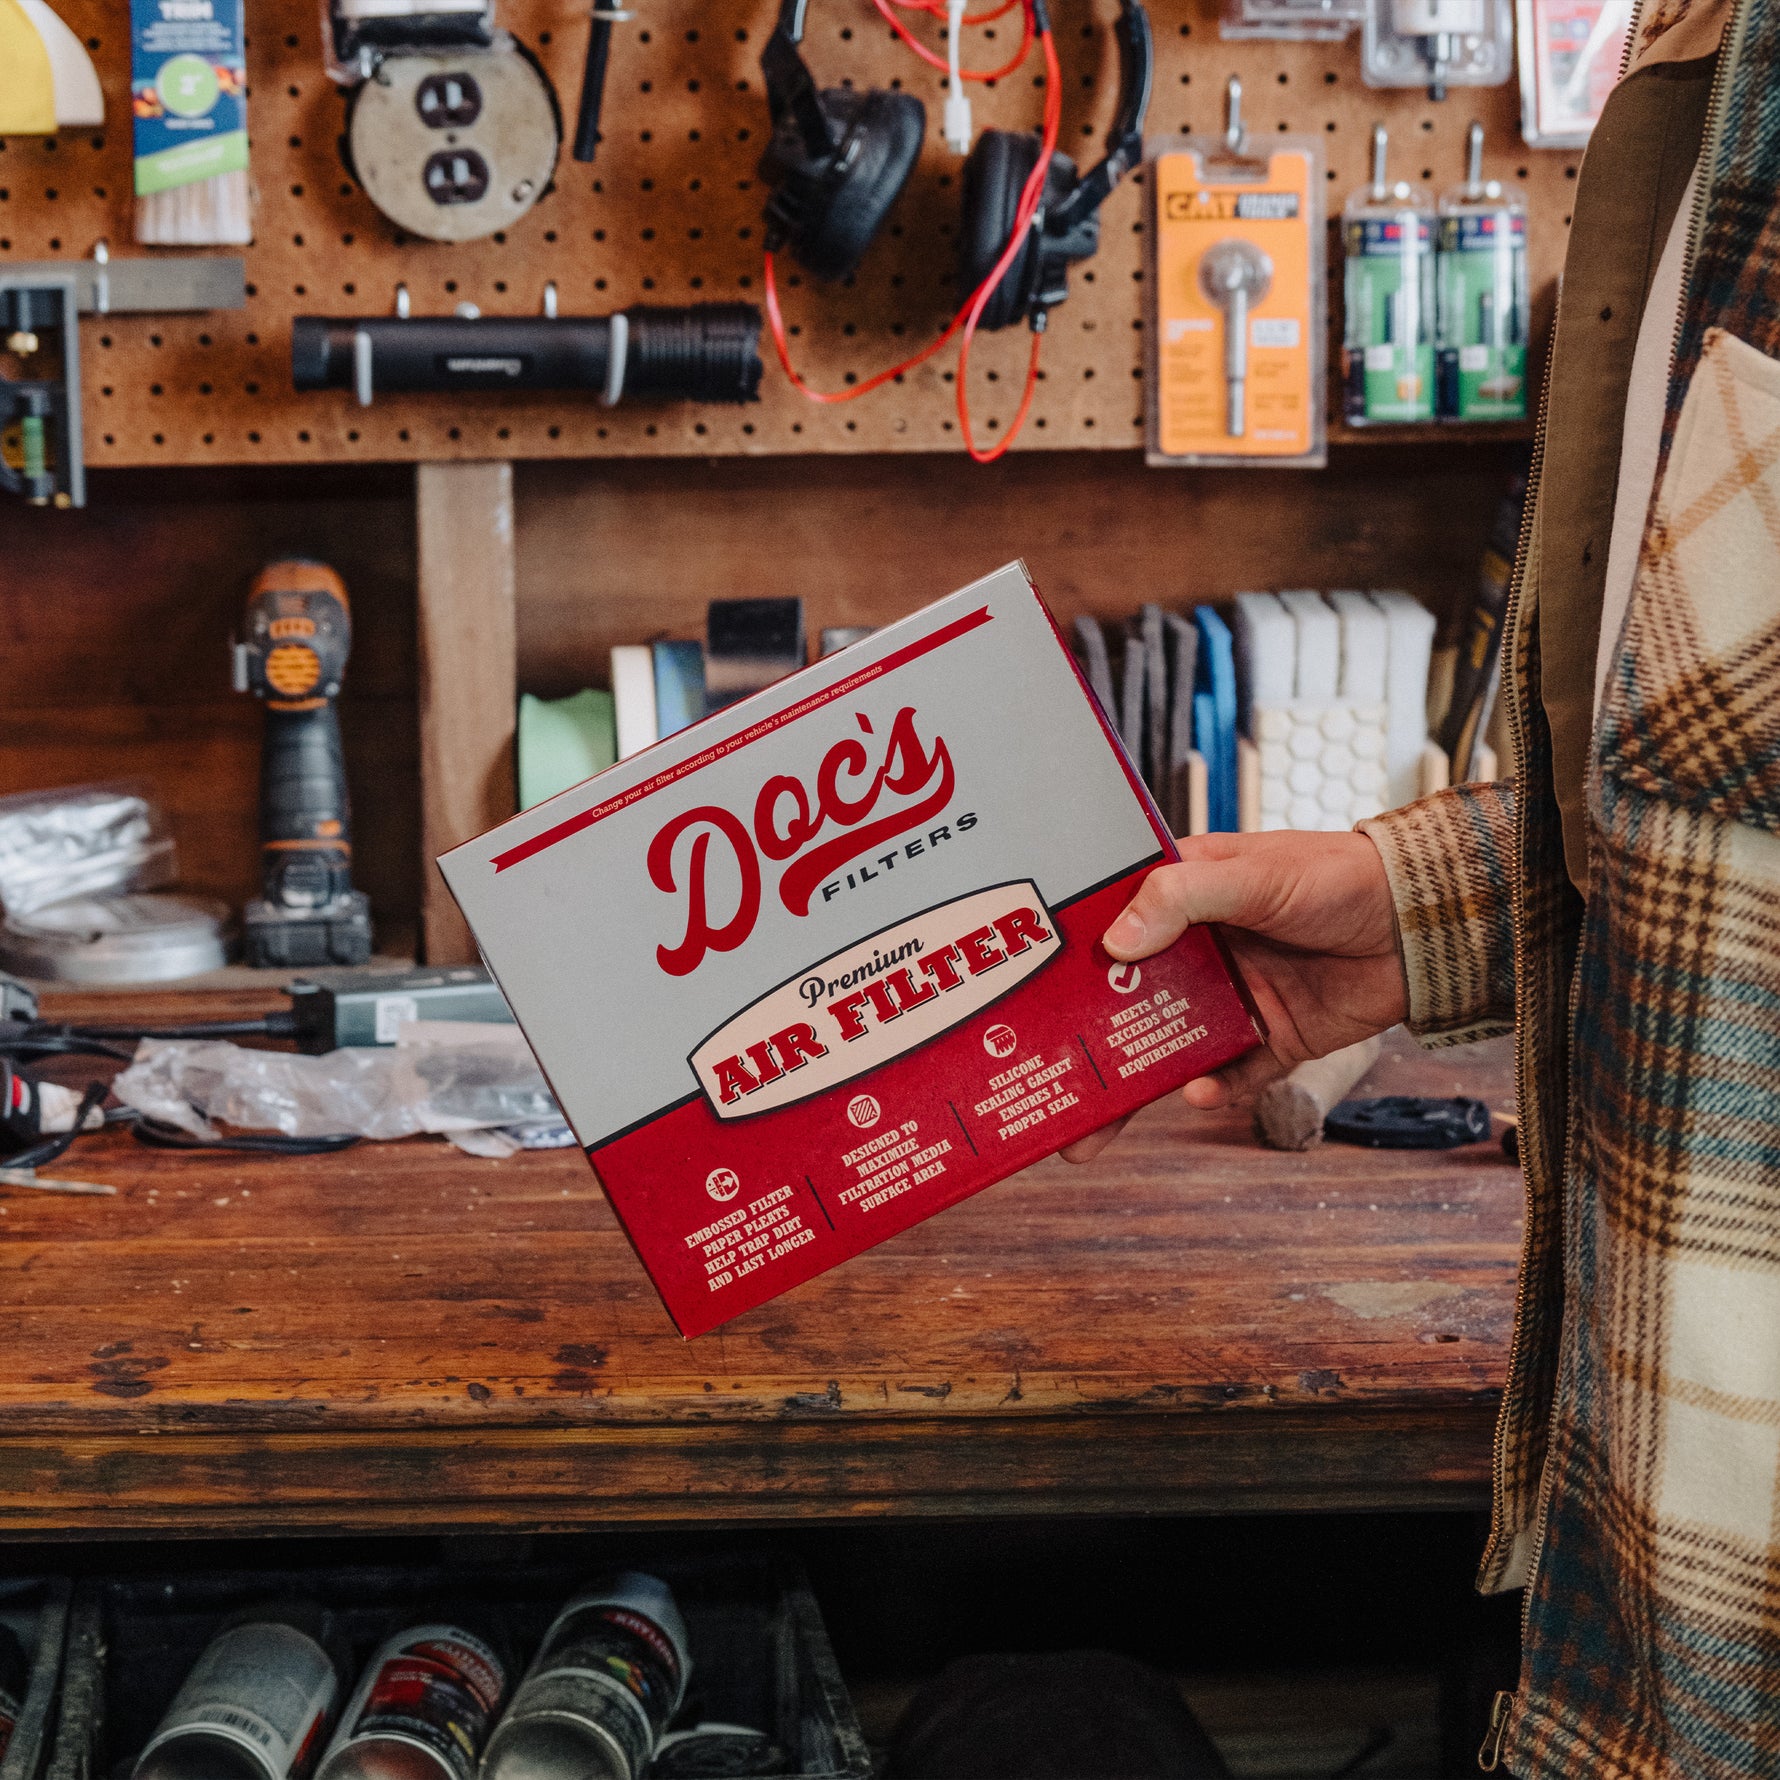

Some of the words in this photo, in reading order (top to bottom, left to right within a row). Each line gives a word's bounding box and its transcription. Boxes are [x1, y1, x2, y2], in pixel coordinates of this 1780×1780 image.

[592, 798, 623, 818] Change
[624, 789, 642, 804] your
[644, 781, 655, 793] air
[655, 772, 675, 787] filter
[676, 752, 716, 776] according
[716, 746, 725, 756] to
[726, 737, 744, 753] your
[744, 718, 779, 740] vehicle's
[780, 692, 830, 722] maintenance
[831, 665, 883, 697] requirements
[647, 706, 955, 977] Doc's
[821, 811, 979, 902] FILTERS
[799, 938, 924, 1008] Premium
[711, 1022, 829, 1105] AIR
[827, 907, 1053, 1043] FILTER
[1106, 1013, 1160, 1049] EXCEEDS
[1162, 997, 1191, 1019] OEM
[1110, 999, 1152, 1028] MEETS
[1153, 989, 1172, 1005] OR
[1117, 1024, 1209, 1079] REQUIREMENTS
[1122, 1016, 1188, 1058] WARRANTY
[974, 1083, 1025, 1117] SEALING
[1027, 1057, 1073, 1089] GASKET
[988, 1054, 1045, 1091] SILICONE
[997, 1108, 1047, 1141] PROPER
[1047, 1092, 1080, 1116] SEAL
[999, 1087, 1051, 1122] ENSURES
[1052, 1081, 1064, 1095] A
[841, 1129, 901, 1167] DESIGNED
[900, 1120, 919, 1136] TO
[856, 1137, 920, 1178] MAXIMIZE
[838, 1160, 910, 1206] FILTRATION
[910, 1139, 953, 1168] MEDIA
[859, 1178, 912, 1213] SURFACE
[912, 1160, 947, 1186] AREA
[684, 1209, 747, 1249] EMBOSSED
[748, 1185, 794, 1216] FILTER
[702, 1229, 744, 1258] PAPER
[743, 1204, 790, 1236] PLEATS
[704, 1250, 737, 1275] HELP
[738, 1233, 770, 1257] TRAP
[772, 1215, 803, 1240] DIRT
[707, 1271, 733, 1292] AND
[734, 1253, 766, 1278] LAST
[766, 1228, 816, 1261] LONGER
